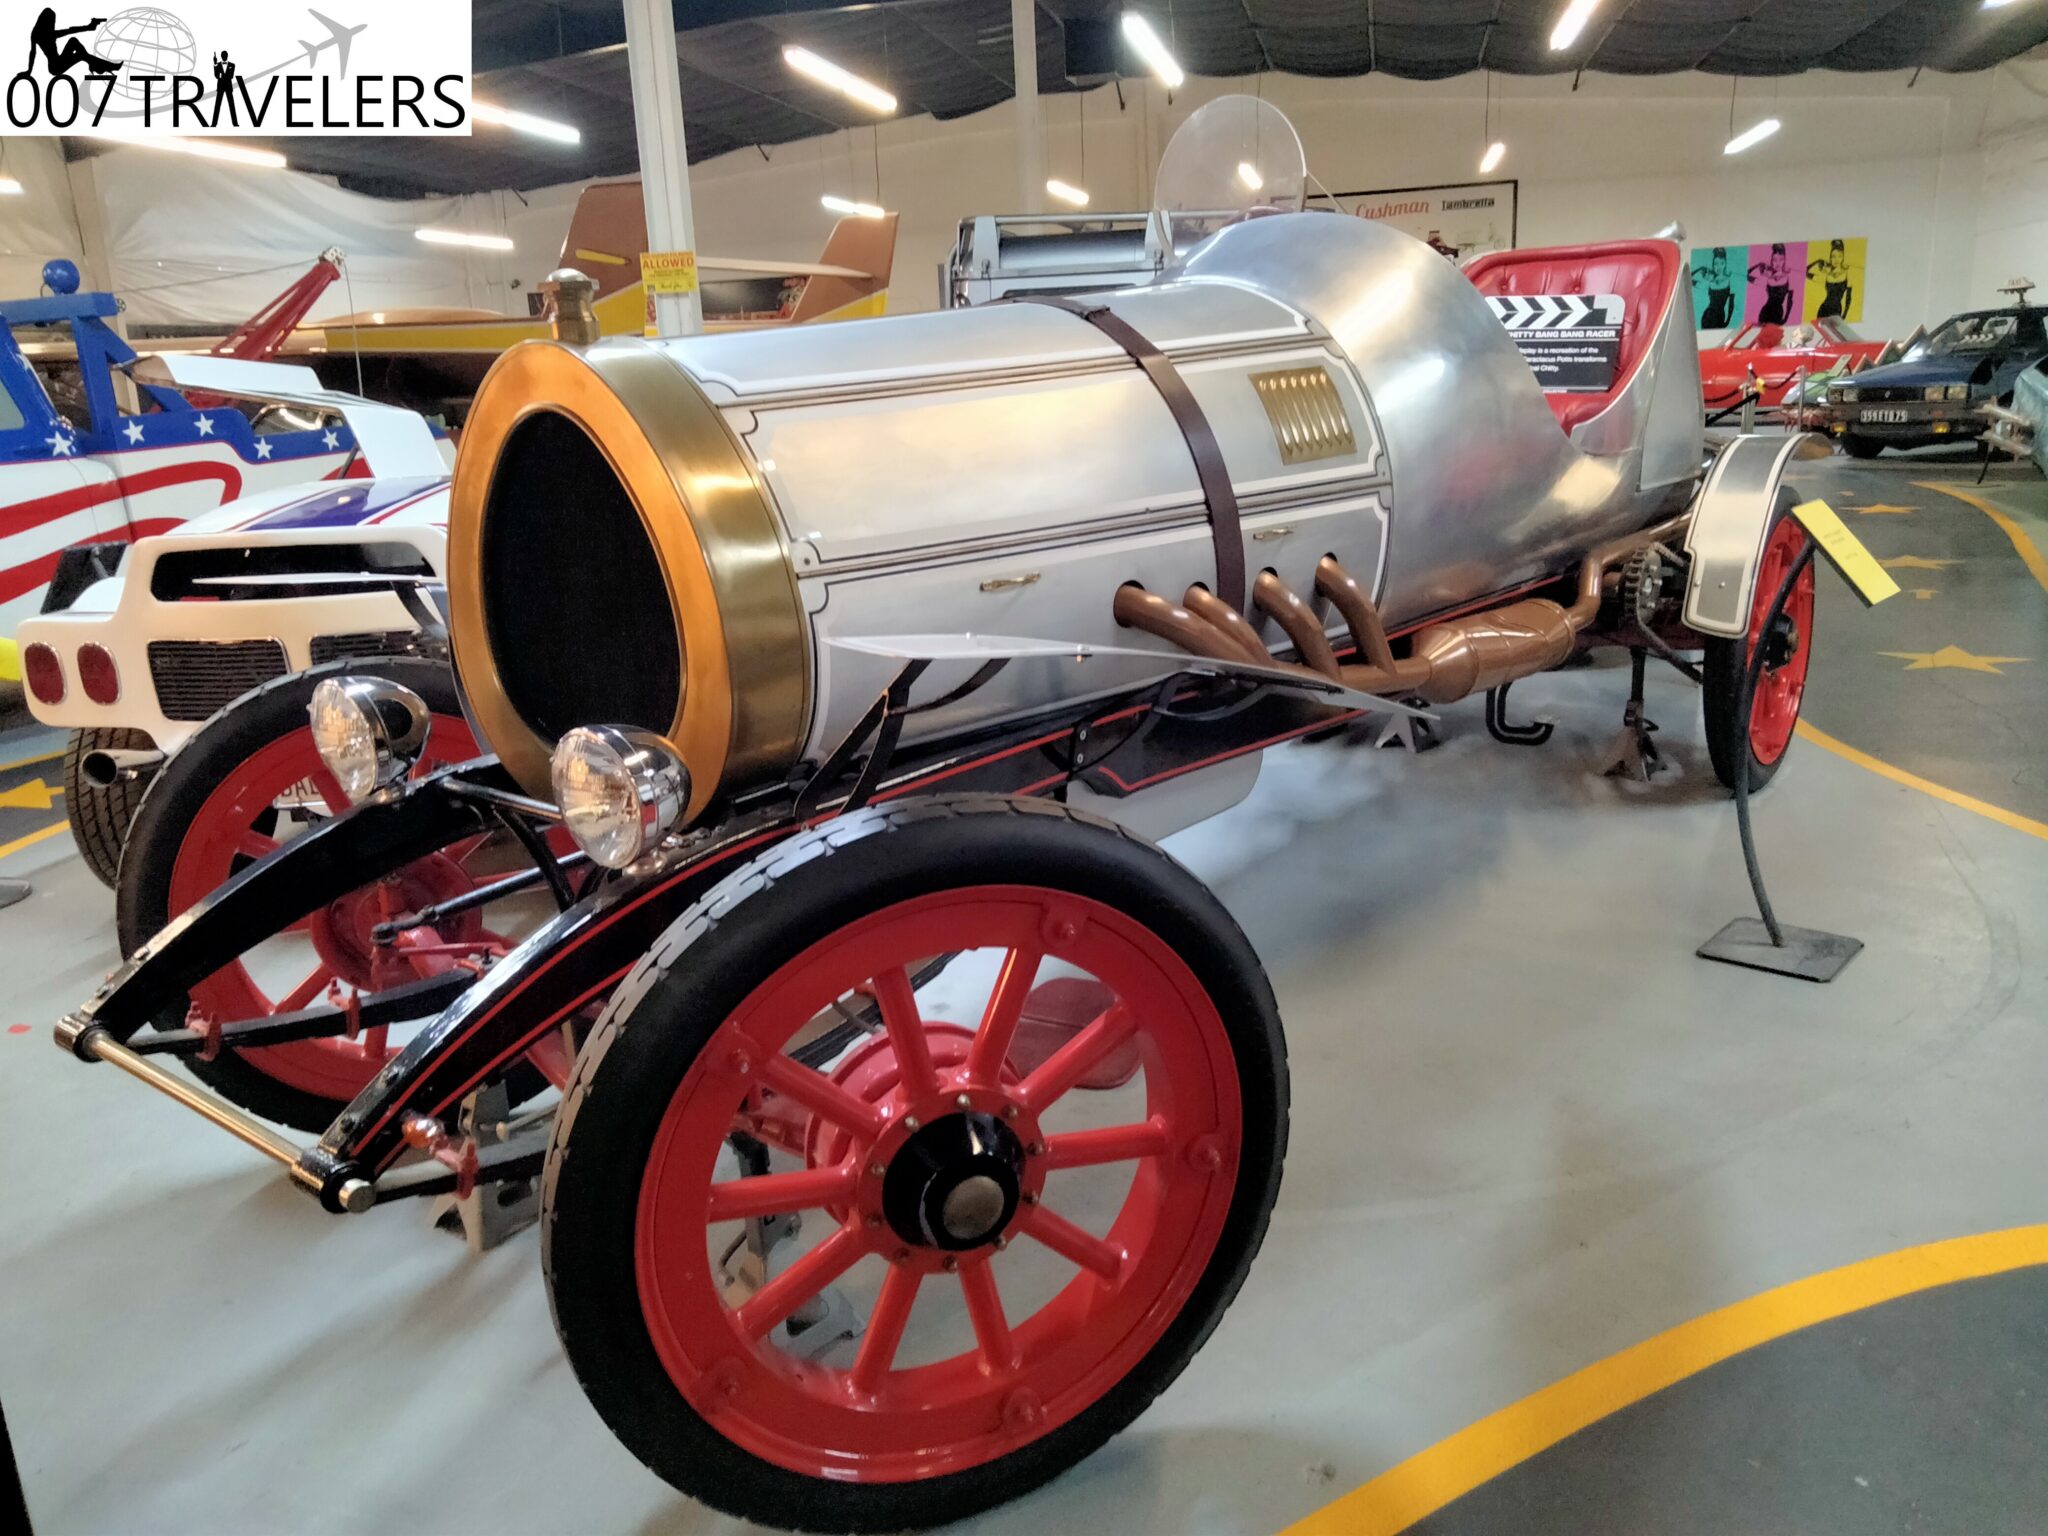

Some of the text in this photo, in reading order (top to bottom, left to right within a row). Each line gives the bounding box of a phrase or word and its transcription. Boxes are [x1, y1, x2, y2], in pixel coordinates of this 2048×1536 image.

[1356, 200, 1430, 220] Cushman
[1442, 197, 1495, 211] Lambretta
[643, 256, 694, 269] ALLOWED
[1509, 330, 1616, 338] HITTY BANG BANG RACER
